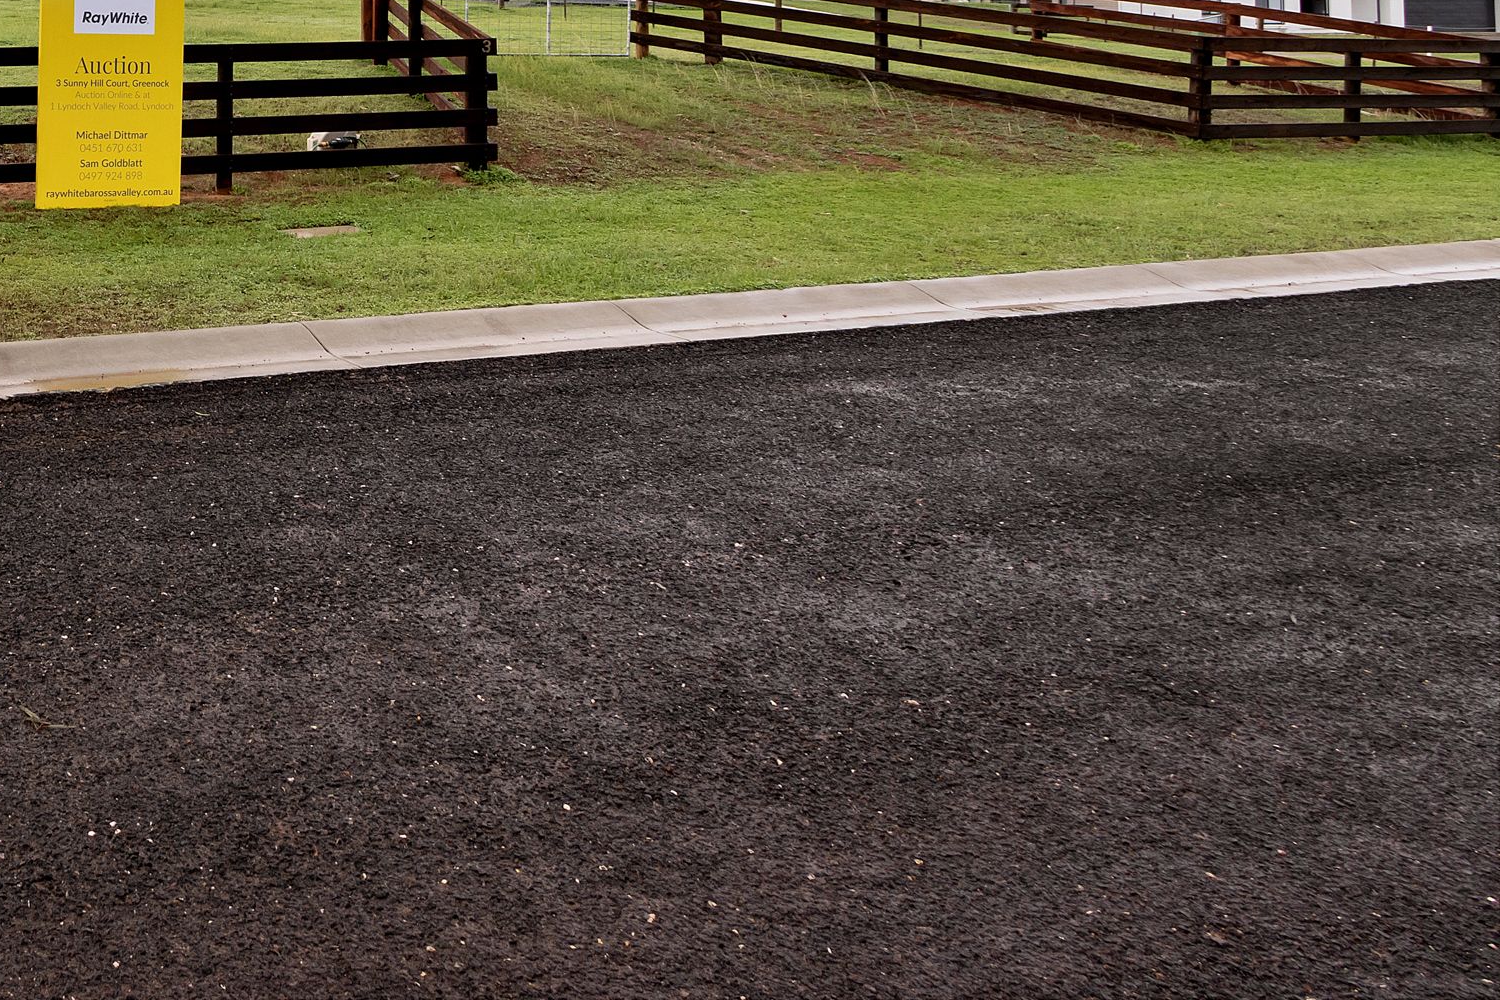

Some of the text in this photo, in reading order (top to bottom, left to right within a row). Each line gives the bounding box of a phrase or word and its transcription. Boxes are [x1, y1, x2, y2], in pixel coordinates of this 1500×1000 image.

[481, 40, 491, 53] 3
[75, 55, 152, 75] Auction
[56, 79, 61, 87] 3
[63, 79, 88, 88] Sunny
[90, 79, 104, 87] Hill
[132, 79, 169, 87] Greenock
[75, 91, 150, 99] Auction Online & at
[57, 102, 91, 111] Lyndoch
[93, 102, 116, 111] Valley
[142, 102, 174, 111] Lyndoch
[76, 130, 148, 140] Michael Dittmar
[80, 143, 143, 152] 0451 670 631
[80, 158, 143, 168] Sam Goldblatt
[79, 171, 143, 181] 0497 924 898
[46, 188, 173, 199] raywhitebarossavalley.com.au
